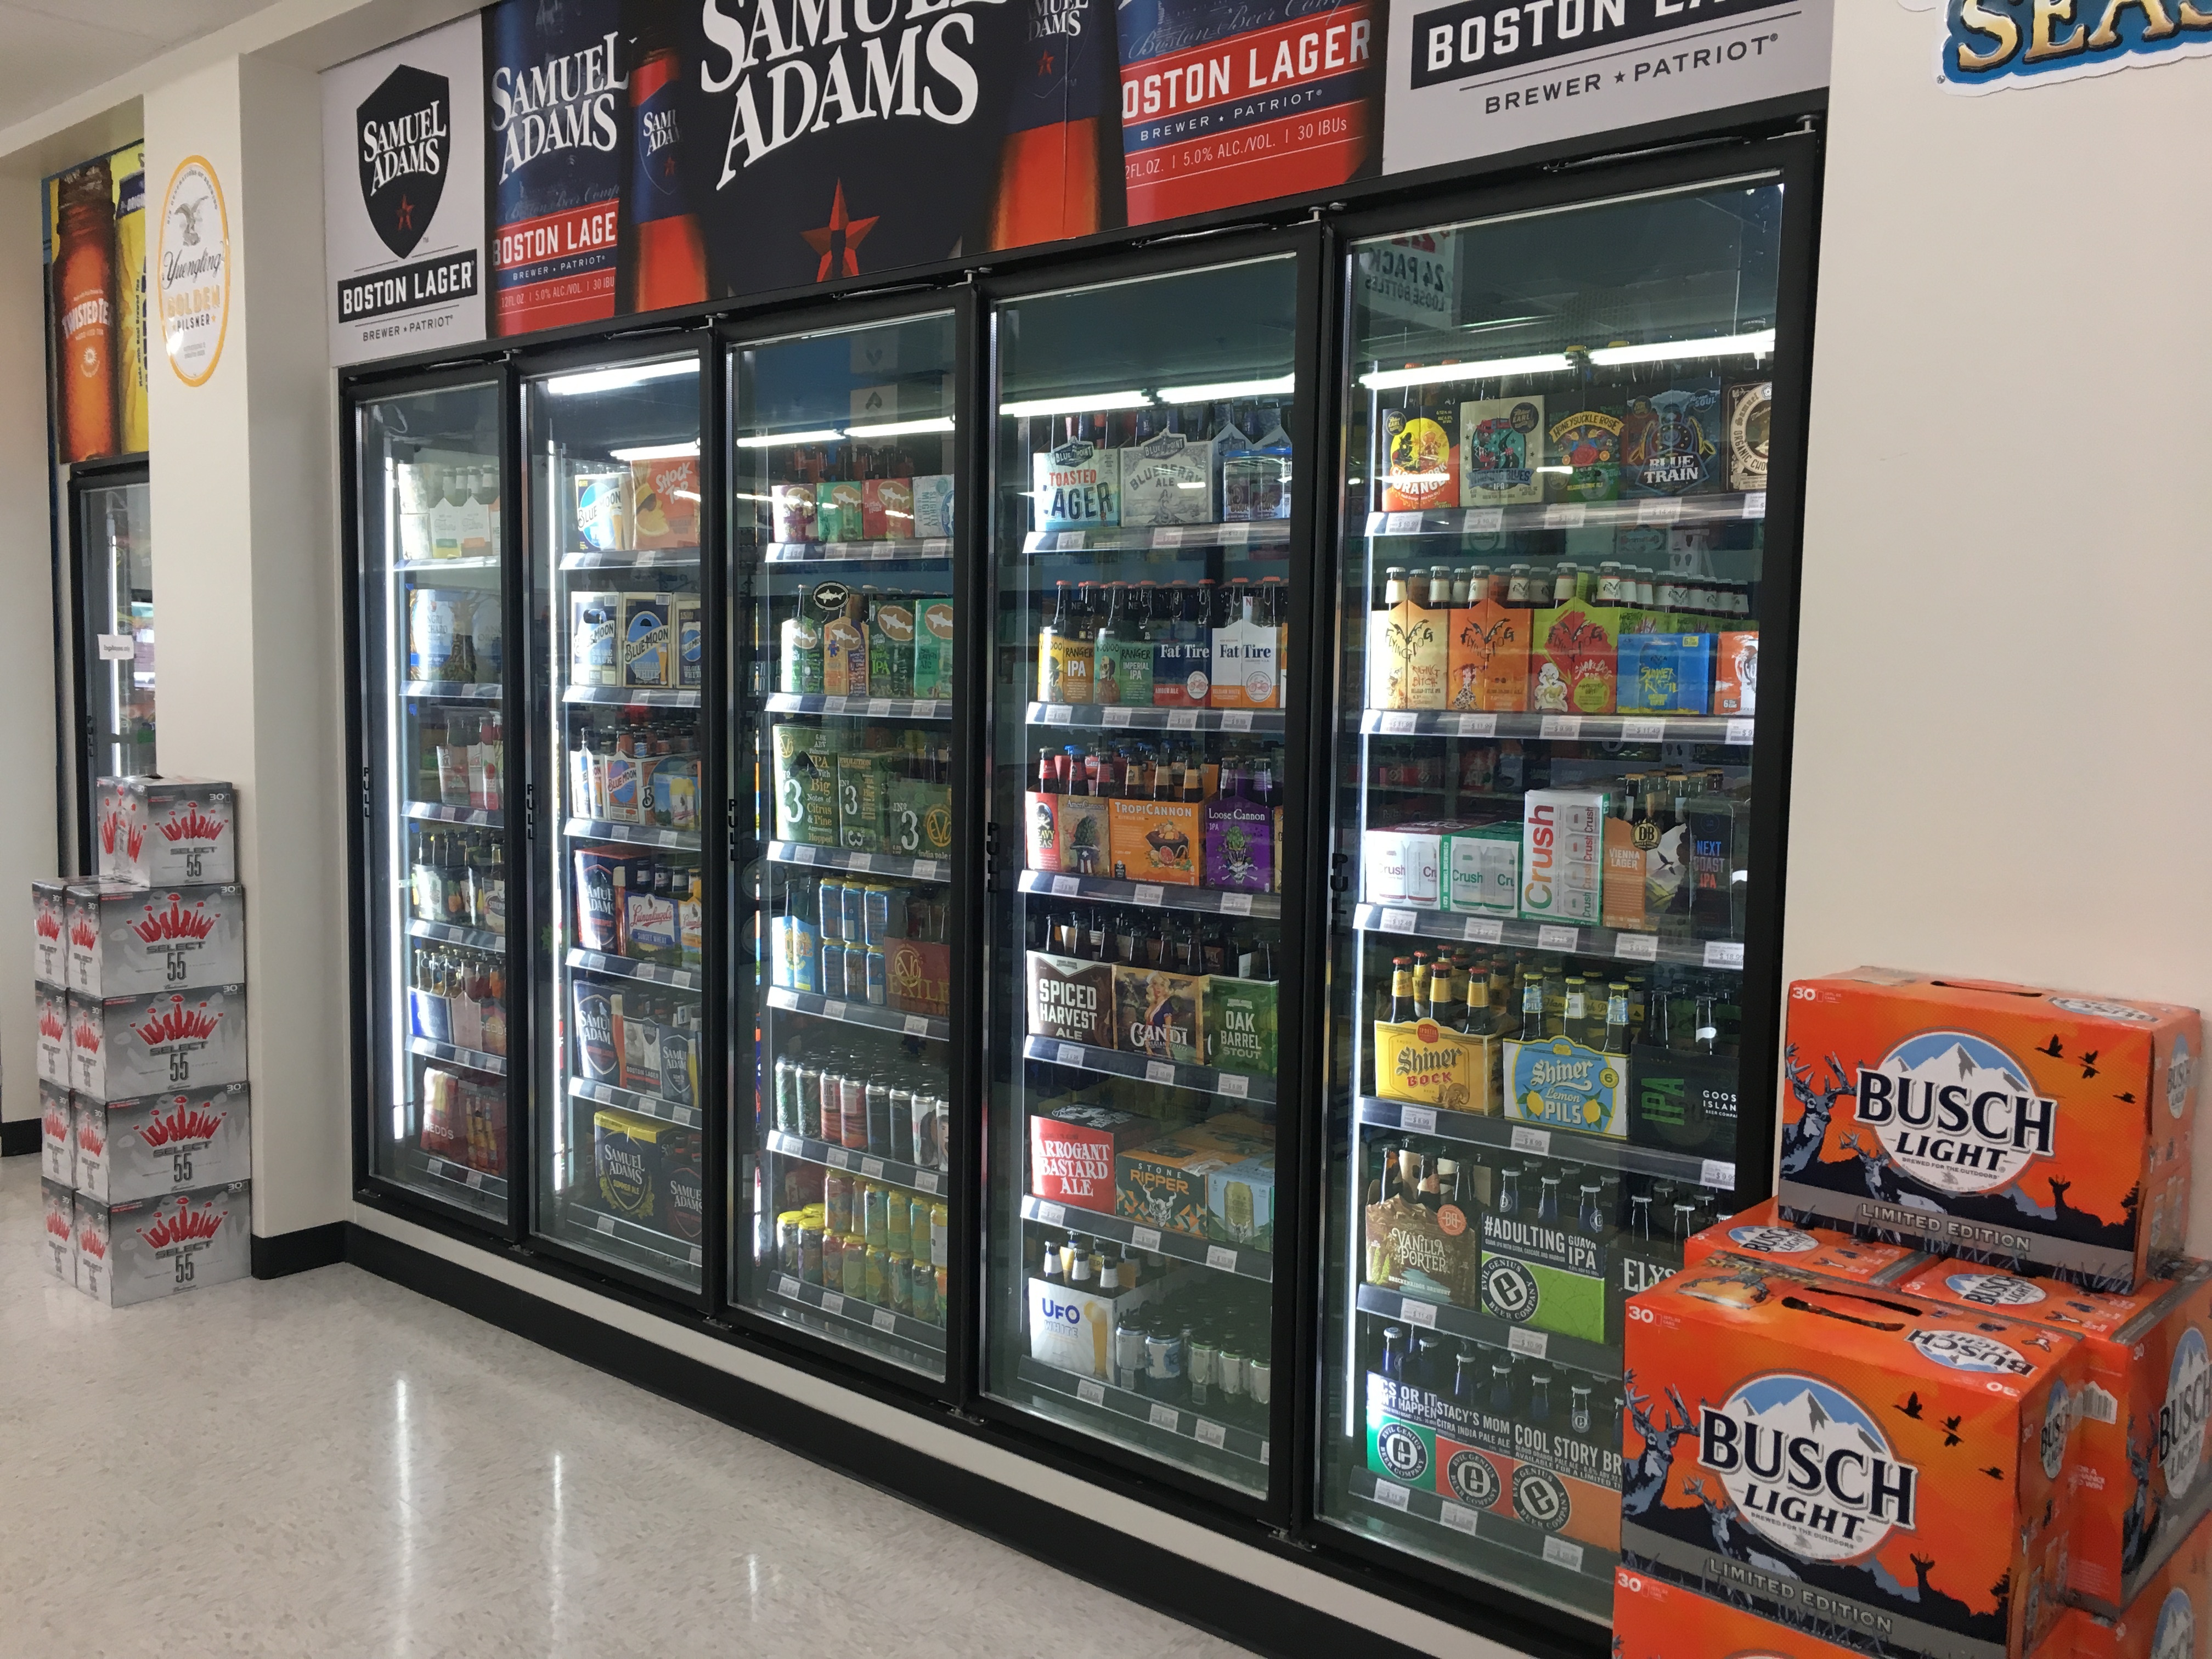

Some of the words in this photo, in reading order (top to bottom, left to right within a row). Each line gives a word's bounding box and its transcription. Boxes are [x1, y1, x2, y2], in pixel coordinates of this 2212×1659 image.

[701, 0, 1008, 93] SAMU
[1427, 0, 1626, 72] BOSTON
[492, 31, 629, 132] SAMUEL
[1122, 54, 1231, 120] OSTON
[1249, 19, 1371, 89] LAGER
[1485, 72, 1601, 114] BREWER
[1634, 34, 1771, 82] PATRIOT
[716, 11, 979, 191] ADAMS
[1141, 116, 1209, 141] BREWER
[1234, 90, 1316, 119] PATRIOT
[363, 100, 447, 163] SAMUEL
[498, 94, 618, 186] ADAMS
[1183, 147, 1213, 167] 5.0%
[1298, 123, 1313, 141] 30
[1318, 117, 1347, 136] IBUs
[370, 138, 439, 196] ADAMS
[493, 224, 558, 266] BOSTON
[567, 212, 617, 253] LAGE
[162, 245, 223, 290] Yuengling
[513, 266, 549, 281] BREWER
[560, 256, 603, 271] PATRIOT
[167, 284, 221, 319] GOLDEN
[343, 276, 407, 315] BOSTON
[415, 263, 472, 301] LAGER
[177, 313, 211, 332] PILSNER
[363, 325, 400, 342] BREWER
[409, 315, 451, 334] PATRIOT
[1553, 413, 1599, 438] HONEYSUCKLE
[1599, 416, 1620, 431] ROSE
[1644, 467, 1699, 484] TRAIN
[1649, 455, 1696, 471] BLUE
[656, 461, 693, 493] SHOCK
[1049, 469, 1097, 487] TOASTED
[1129, 463, 1203, 492] BLUEBERRY
[1155, 477, 1175, 488] ALE
[1065, 646, 1094, 659] RANGER
[1121, 647, 1151, 661] RANGER
[1160, 644, 1181, 658] Fat
[1184, 643, 1210, 658] Tire
[1219, 644, 1240, 658] Fat
[1244, 644, 1272, 659] Tire
[1067, 659, 1086, 678] IPA
[1122, 661, 1150, 670] IMPERIAL
[1129, 669, 1142, 681] IPA
[1115, 801, 1192, 818] TROPICANNON
[1209, 807, 1232, 820] Loose
[1233, 808, 1266, 821] Cannon
[1584, 806, 1594, 833] Crush
[728, 798, 739, 862] PULL
[170, 846, 217, 856] SELECT
[986, 821, 1001, 893] PULL
[1525, 804, 1554, 910] Crush
[1583, 836, 1593, 862] Crush
[1609, 847, 1640, 860] VIENNA
[1696, 840, 1722, 857] NEXT
[186, 854, 202, 877] 55
[1452, 869, 1483, 884] Crush
[1611, 857, 1638, 871] LAGER
[1693, 857, 1725, 873] COAST
[146, 940, 206, 954] SELECT
[167, 951, 187, 981] 55
[1039, 978, 1097, 1011] SPICED
[1792, 987, 1816, 1002] 30
[1040, 1003, 1098, 1031] HARVEST
[1226, 1009, 1255, 1033] OAK
[1055, 1027, 1083, 1041] ALE
[1220, 1030, 1262, 1050] BARREL
[149, 1041, 208, 1056] SELECT
[1222, 1046, 1261, 1060] STOUT
[1396, 1046, 1464, 1076] Shiner
[169, 1052, 189, 1081] 55
[1530, 1059, 1594, 1087] Shiner
[1407, 1071, 1453, 1088] BOCK
[1545, 1088, 1581, 1104] Lemon
[1702, 1090, 1737, 1103] GOOS
[1702, 1099, 1737, 1113] ISLAN
[1545, 1101, 1582, 1125] PILS
[1857, 1067, 2058, 1156] BUSCH
[153, 1140, 212, 1156] SELECT
[605, 1143, 646, 1172] SAMUEL
[1039, 1139, 1110, 1163] ARROGANT
[1895, 1131, 2008, 1172] LIGHT
[173, 1153, 193, 1182] 55
[609, 1158, 643, 1185] ADAMS
[1040, 1156, 1109, 1181] BASTARD
[1138, 1162, 1182, 1180] STONE
[1901, 1156, 1931, 1167] BREWED
[1931, 1162, 1945, 1170] FOR
[1059, 1176, 1094, 1198] ALE
[1130, 1169, 1190, 1195] RIPPER
[1484, 1215, 1566, 1255] #ADULTING
[1861, 1203, 1942, 1235] LIMITED
[1946, 1221, 2032, 1252] EDITION
[155, 1239, 213, 1259] SELECT
[1568, 1235, 1597, 1251] GUAVA
[175, 1253, 194, 1283] 55
[1398, 1245, 1451, 1274] PORTER
[1488, 1258, 1522, 1273] GENIUS
[1568, 1247, 1597, 1270] IPA
[1042, 1297, 1081, 1325] UFO
[1628, 1306, 1654, 1323] 30
[1043, 1319, 1079, 1339] WHITE
[1905, 1329, 2038, 1377] BUSCH
[1399, 1397, 1437, 1419] HAPPEN
[1401, 1385, 1419, 1404] OR
[1424, 1392, 1437, 1407] IT
[1436, 1401, 1480, 1426] STACY'S
[1483, 1415, 1510, 1435] MOM
[1436, 1418, 1456, 1432] CITRA
[1457, 1425, 1477, 1438] INDIA
[1478, 1431, 1496, 1444] PALE
[1497, 1436, 1510, 1448] ALE
[1515, 1423, 1550, 1454] COOL
[1553, 1435, 1599, 1468] STORY
[1698, 1406, 1918, 1531] BUSCH
[1742, 1483, 1865, 1541] LIGHT
[1617, 1572, 1642, 1593] 30
[1708, 1557, 1796, 1600] LIMITED
[1801, 1589, 1893, 1635] EDITION
